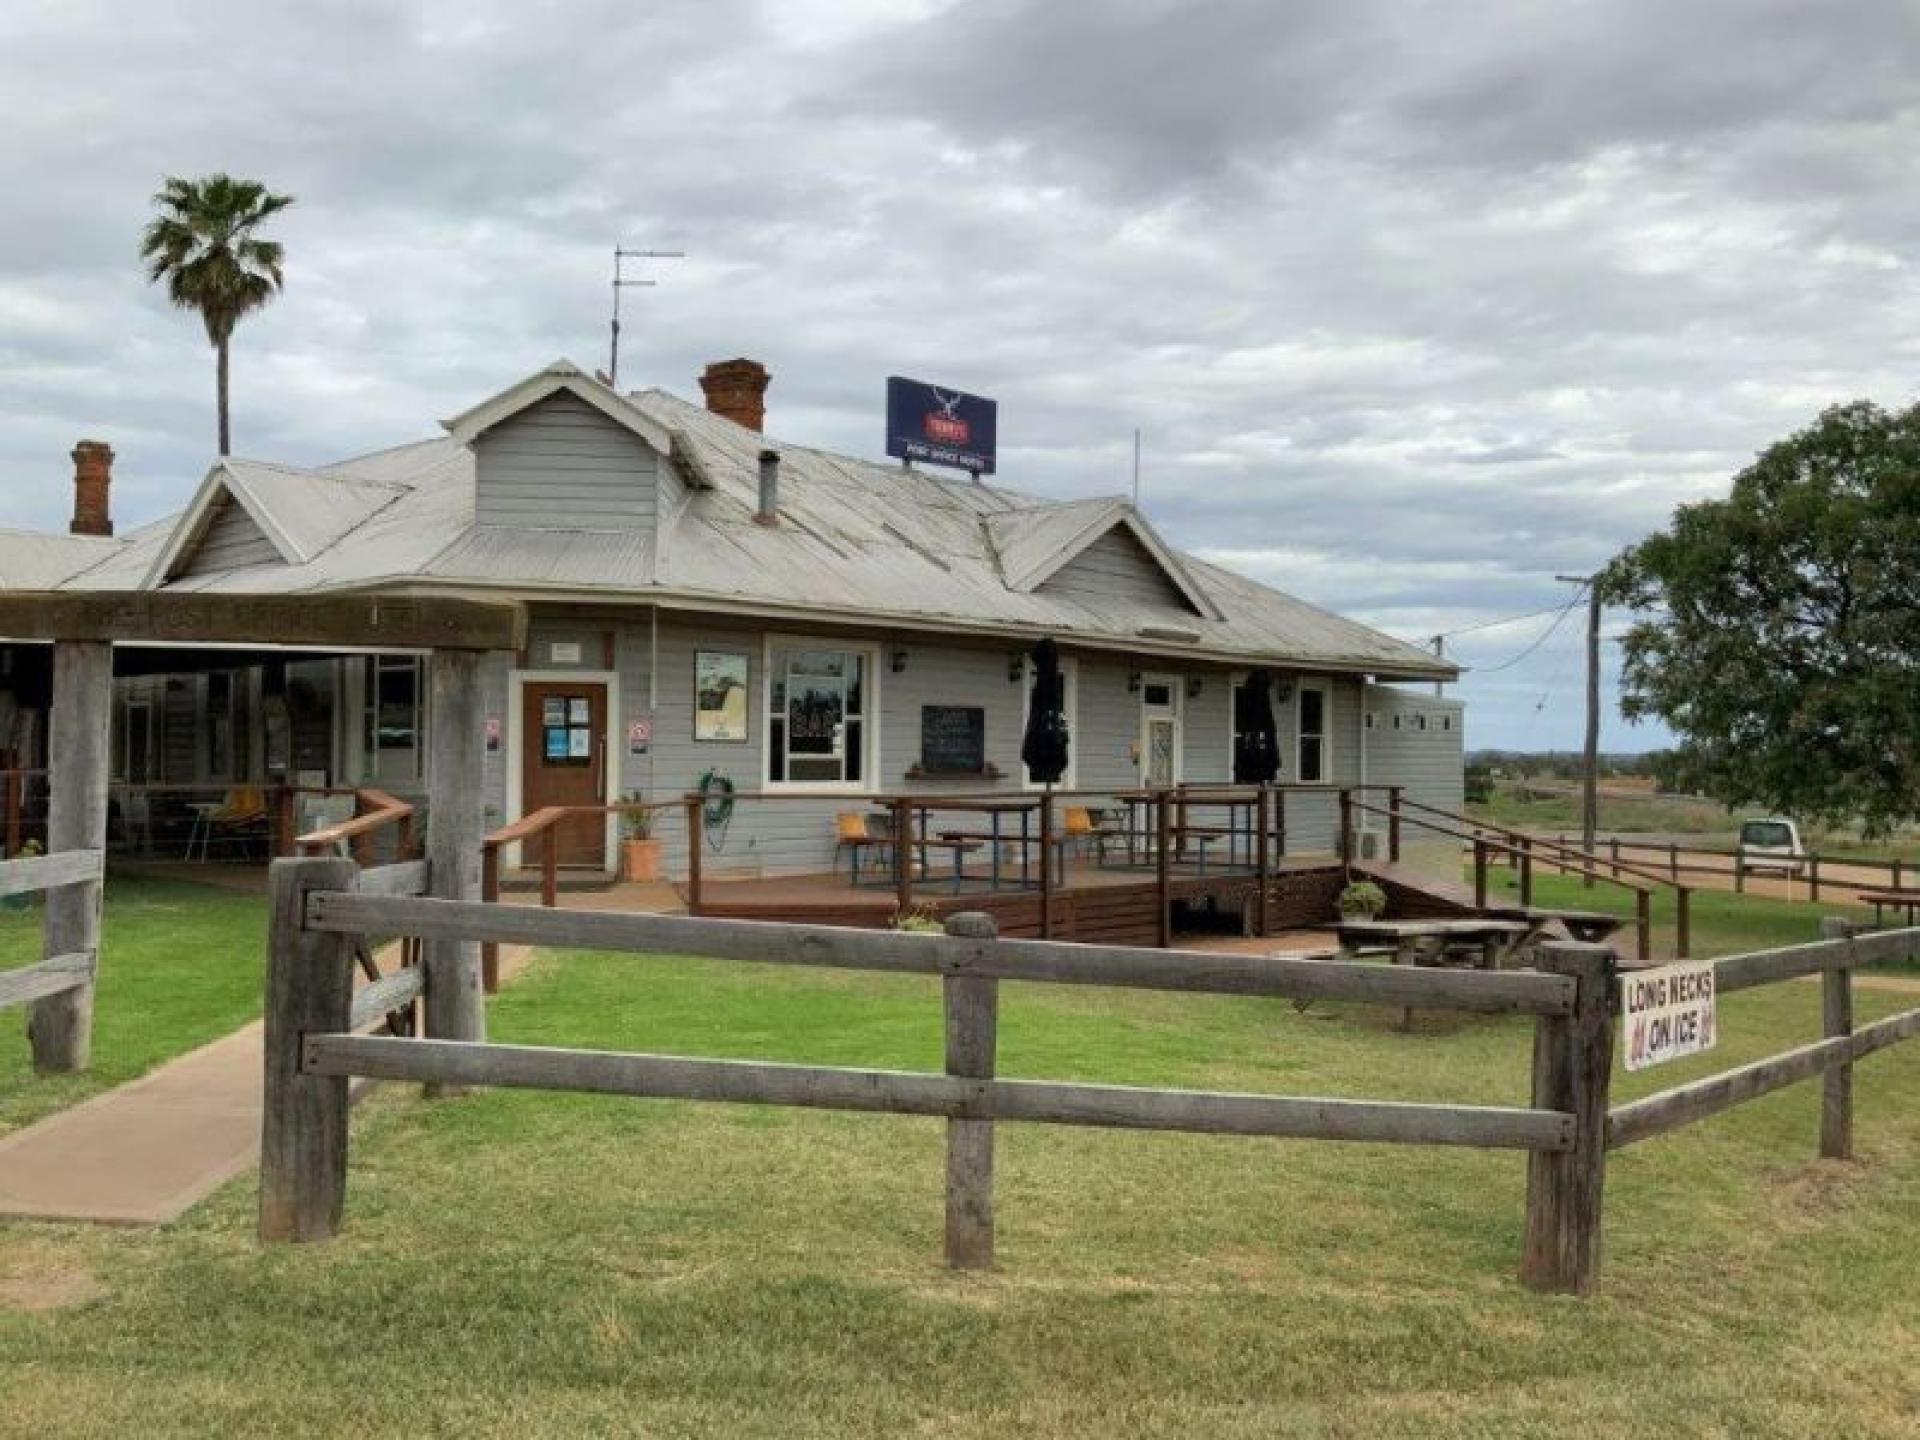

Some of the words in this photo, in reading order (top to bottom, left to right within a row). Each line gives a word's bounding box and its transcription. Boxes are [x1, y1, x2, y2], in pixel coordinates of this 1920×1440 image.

[1627, 978, 1667, 1013] LONG
[1670, 970, 1712, 1004] NECKS
[1649, 1016, 1671, 1051] ON
[1675, 1009, 1698, 1047] ICE
